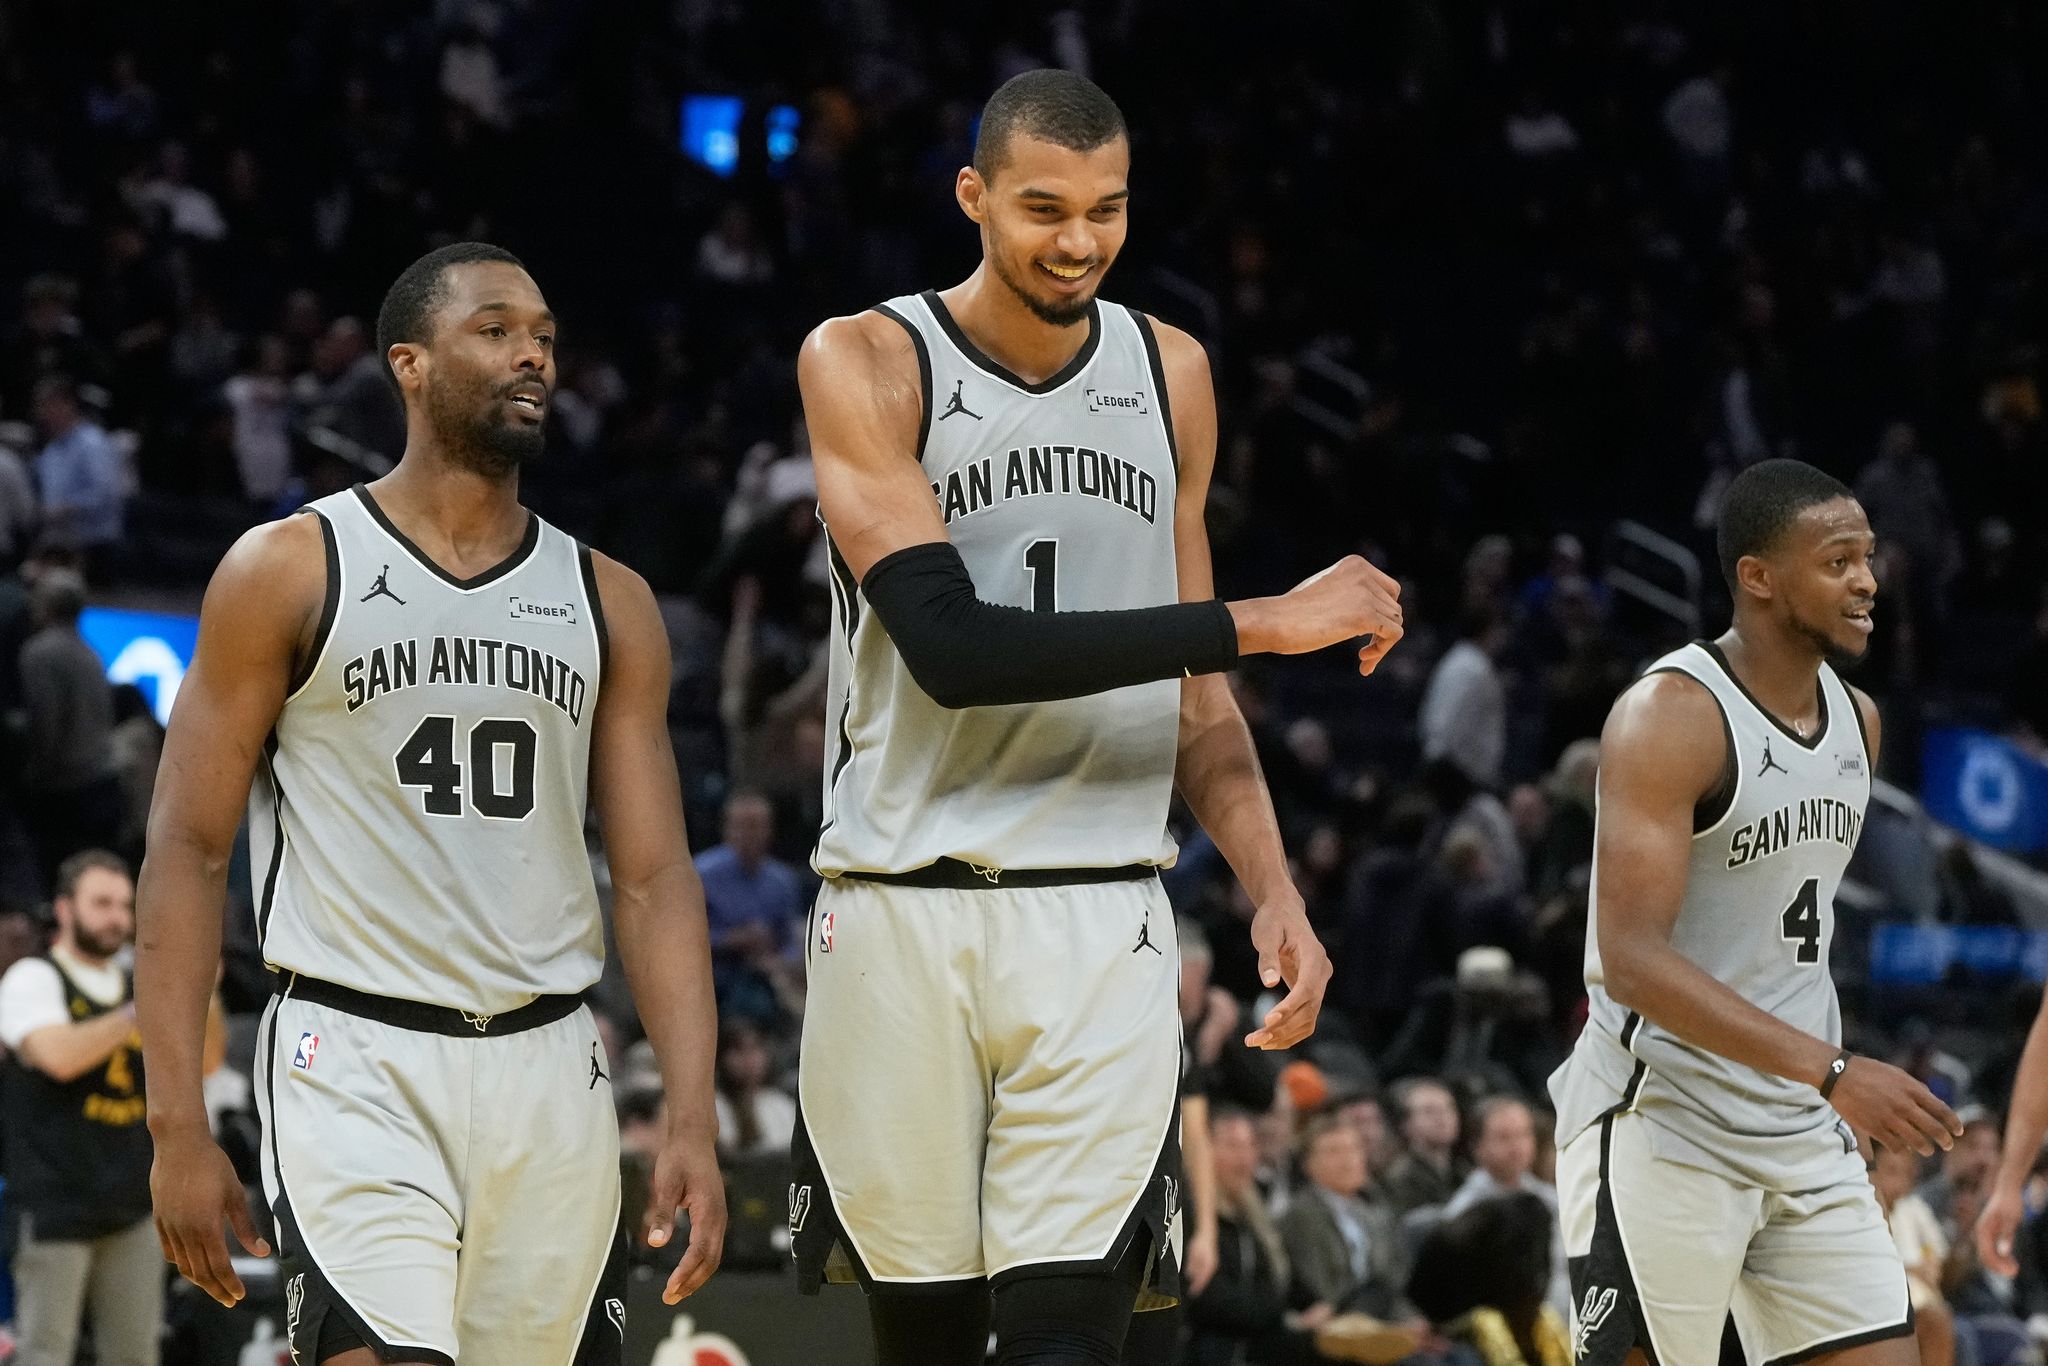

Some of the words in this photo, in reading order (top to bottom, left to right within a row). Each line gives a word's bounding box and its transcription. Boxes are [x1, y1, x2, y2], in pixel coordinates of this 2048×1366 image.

[1096, 396, 1139, 408] LEDGER
[1003, 444, 1156, 527] ANTONIO
[519, 603, 568, 617] LEDGER
[1024, 538, 1059, 613] 1
[342, 637, 418, 715] SAN
[426, 636, 586, 731] ANTONIO
[393, 714, 539, 822] 40
[1726, 803, 1790, 870] SAN
[1780, 875, 1821, 966] 4
